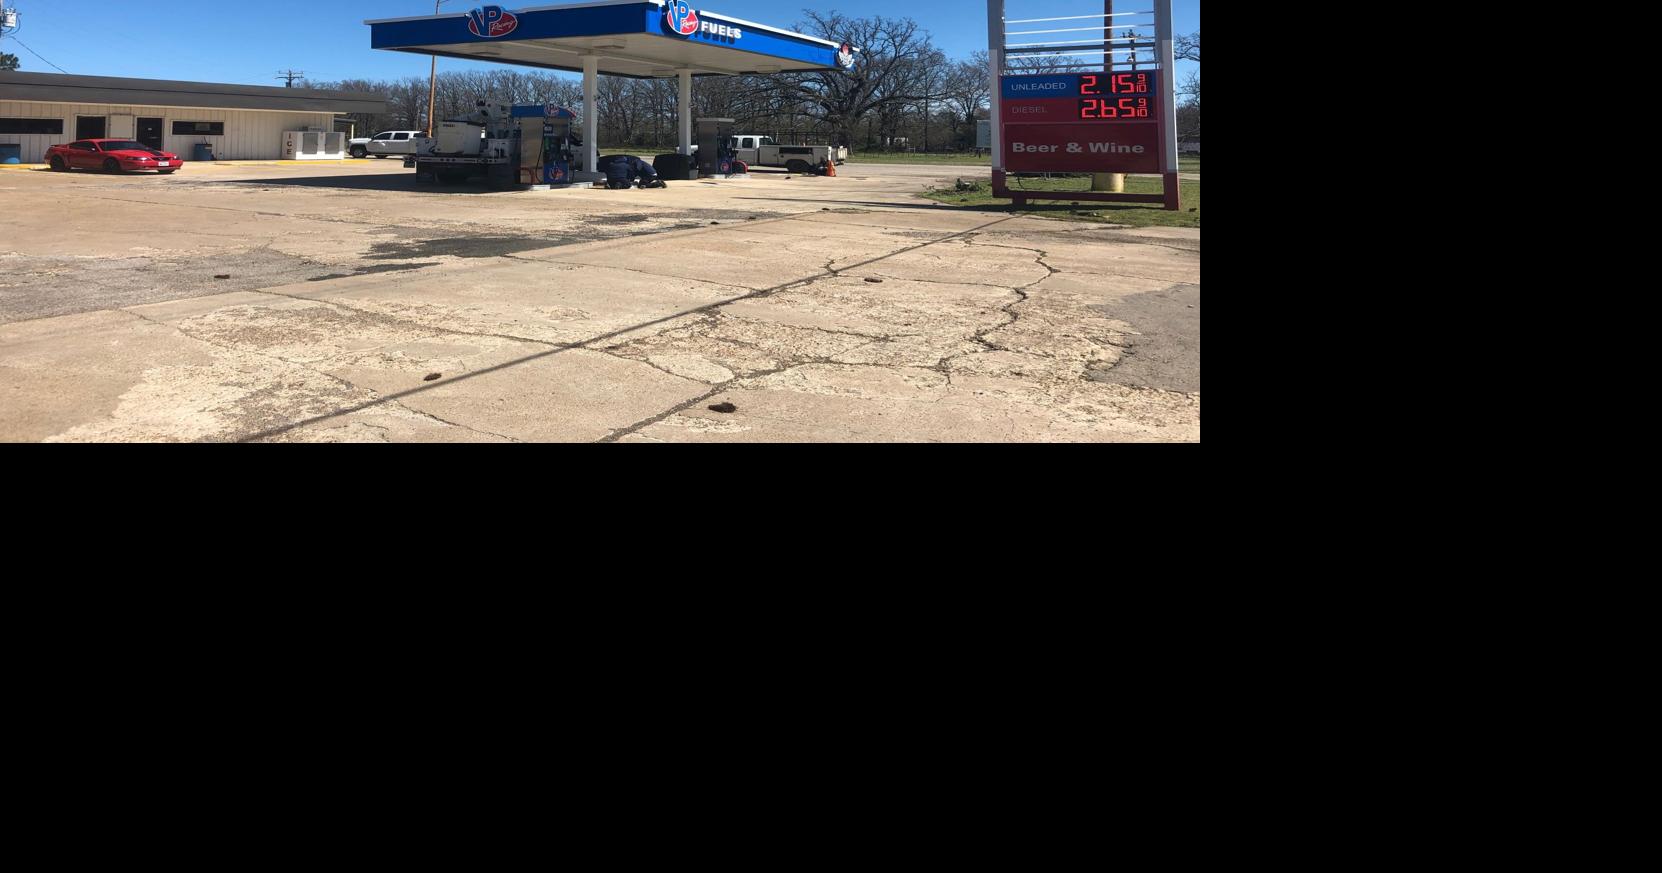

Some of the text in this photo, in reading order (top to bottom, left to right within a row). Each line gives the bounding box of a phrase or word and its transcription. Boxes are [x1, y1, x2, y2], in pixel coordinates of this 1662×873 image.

[470, 6, 502, 37] VP
[668, 0, 690, 33] VP
[701, 20, 742, 39] FUELS
[1011, 74, 1134, 94] UNLEADED 2.15
[1012, 98, 1136, 118] DIESEL 2.65
[1012, 142, 1145, 153] Beer & Wine
